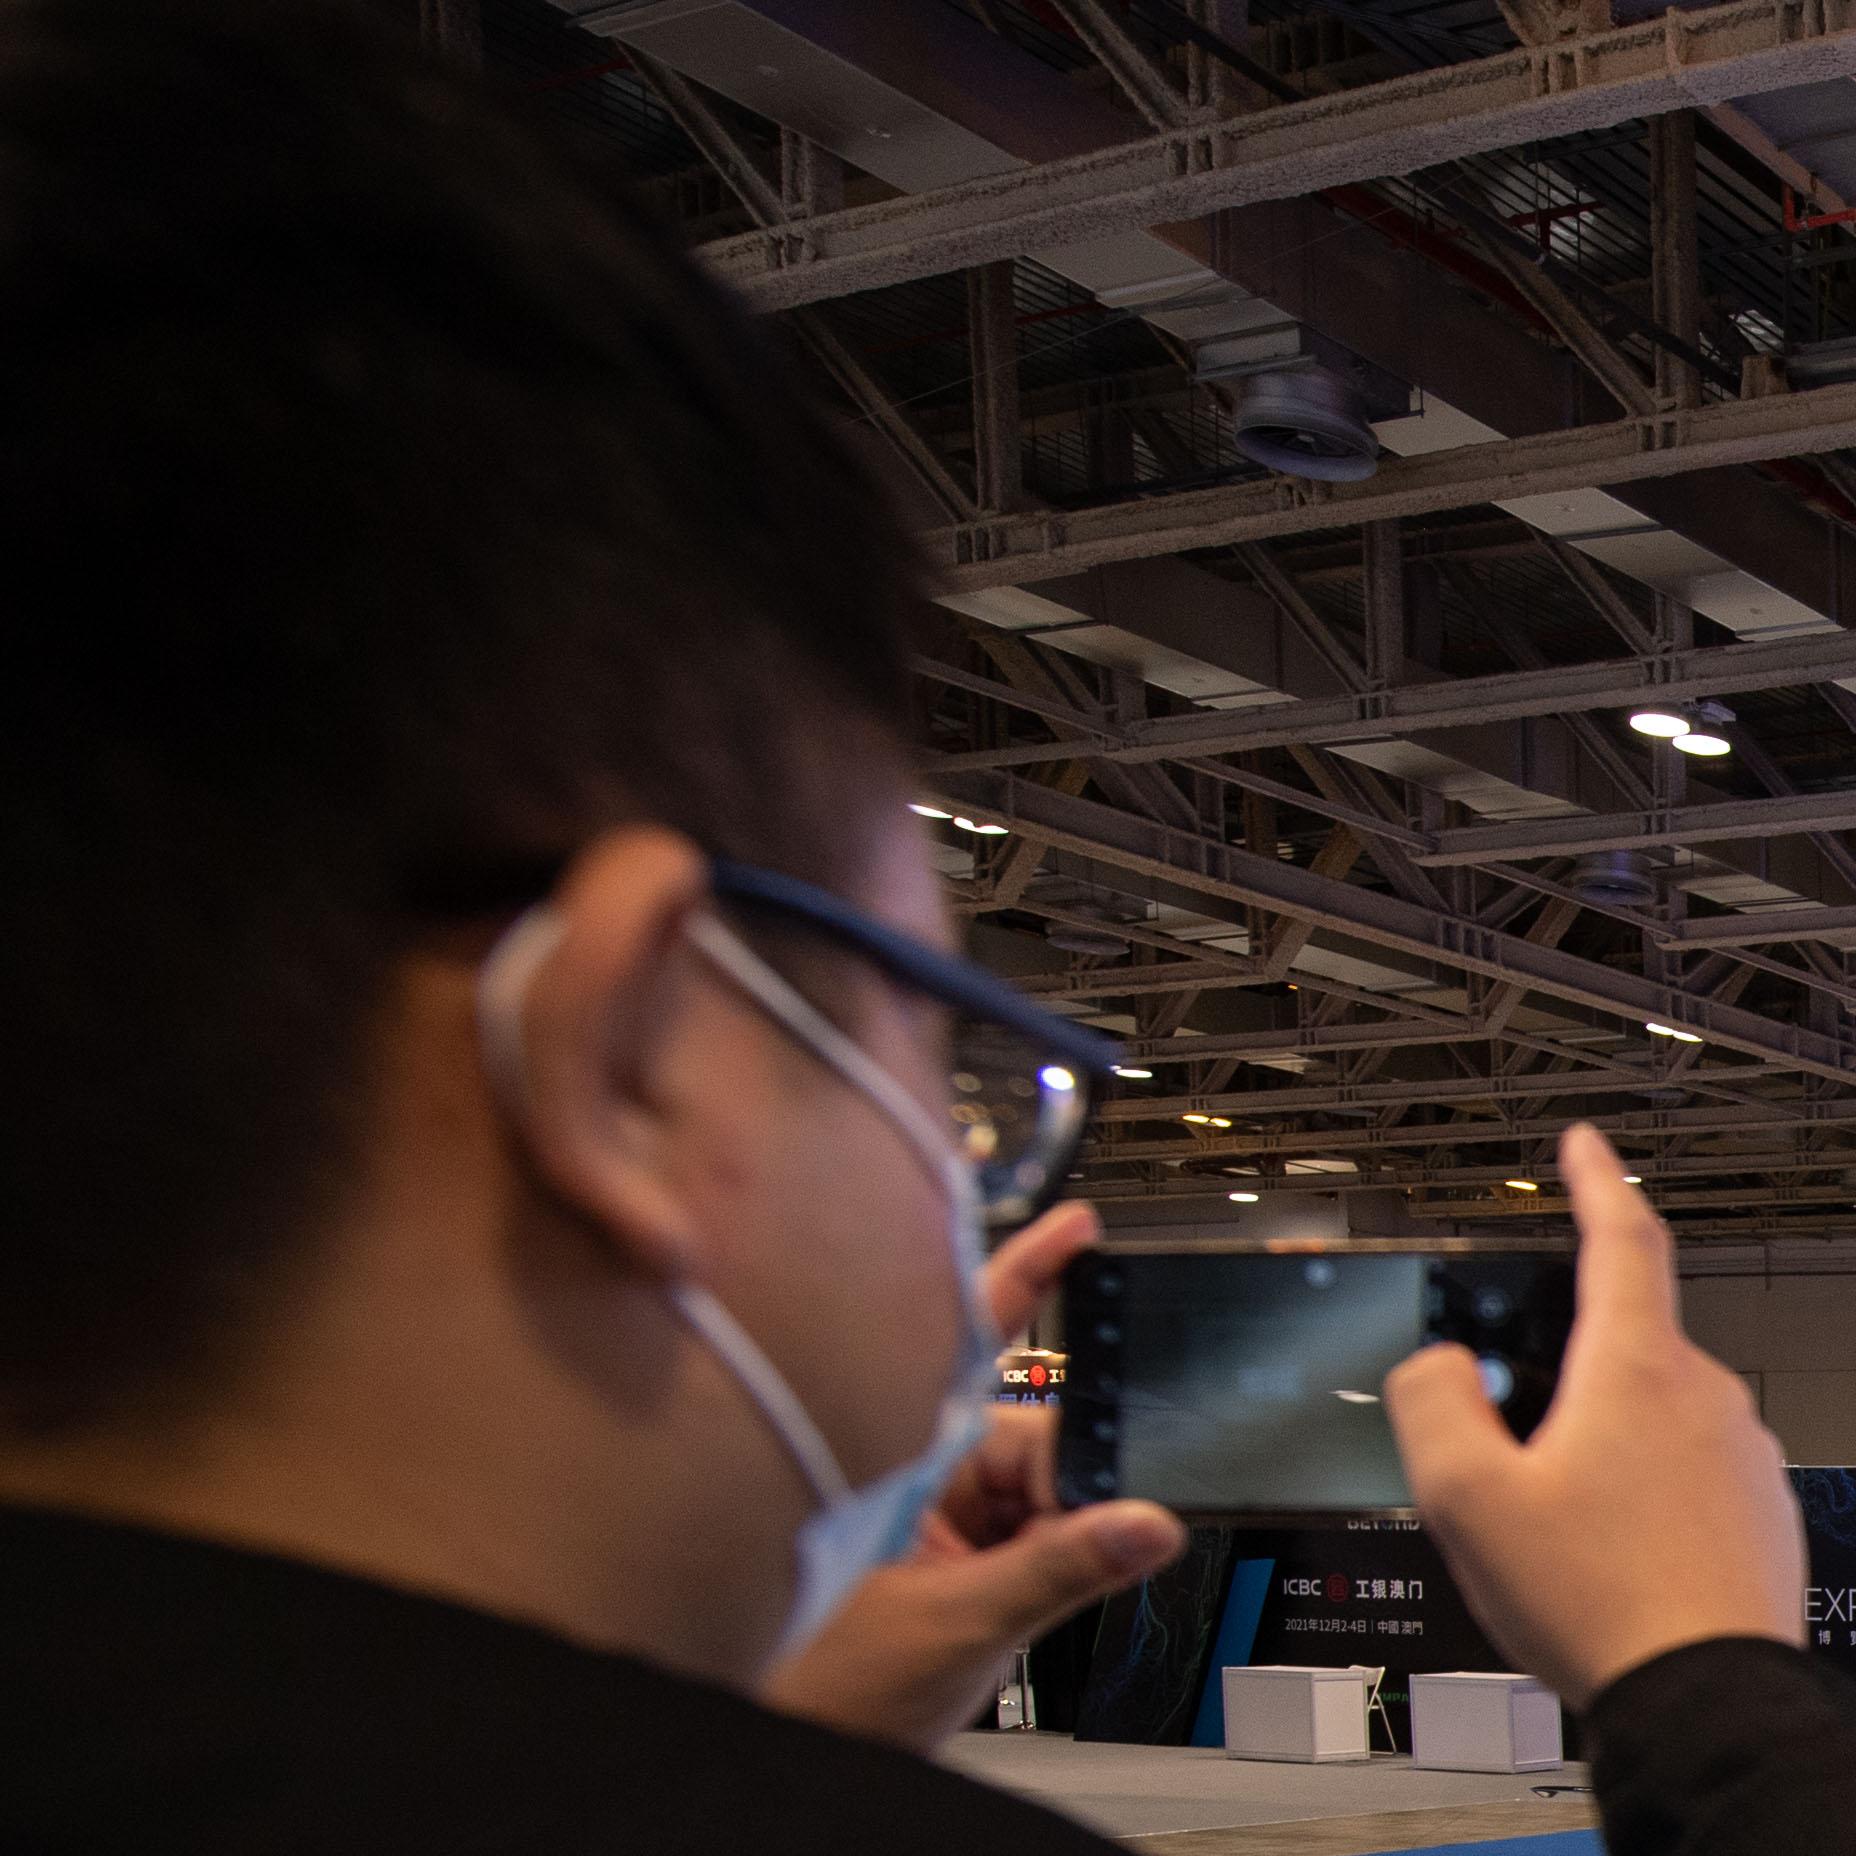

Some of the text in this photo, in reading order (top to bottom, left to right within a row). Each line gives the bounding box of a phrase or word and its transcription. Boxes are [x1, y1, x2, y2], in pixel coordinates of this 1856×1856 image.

[1003, 1369, 1029, 1383] ICBC
[1283, 1579, 1424, 1600] ICBC 工银澳门
